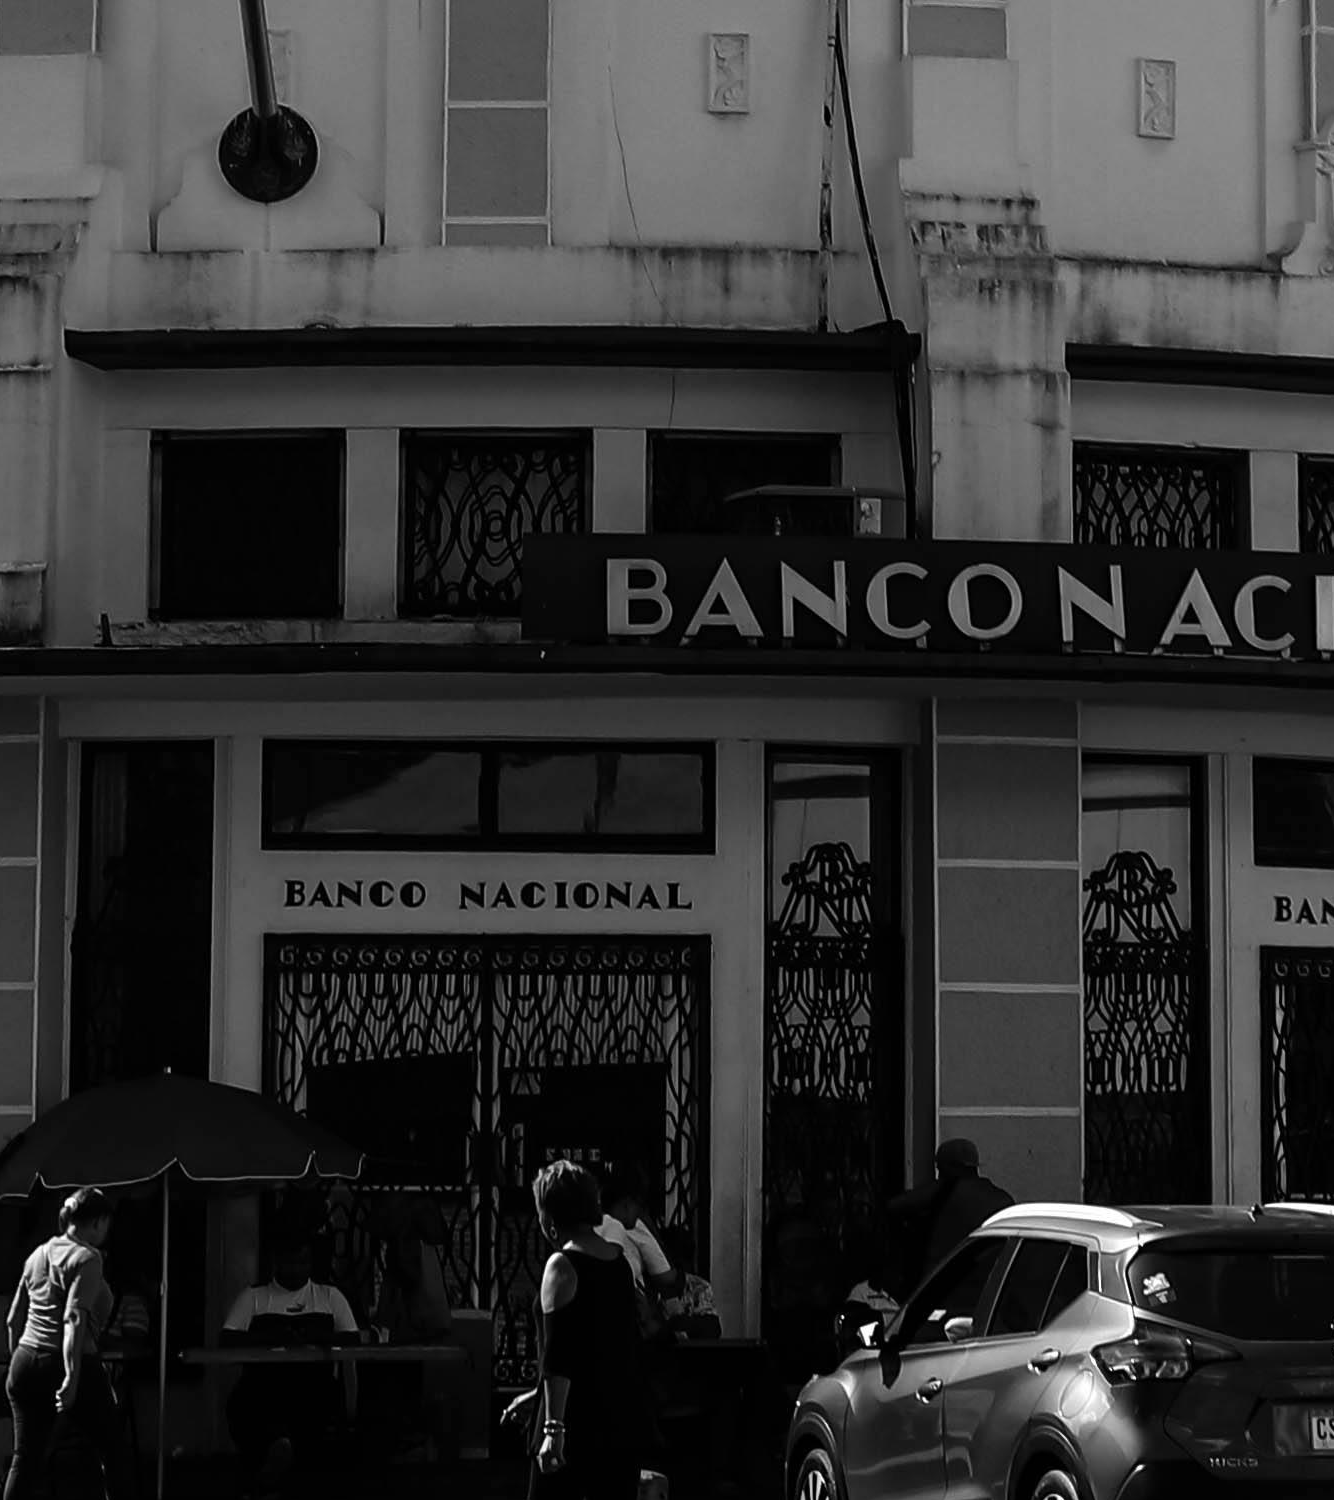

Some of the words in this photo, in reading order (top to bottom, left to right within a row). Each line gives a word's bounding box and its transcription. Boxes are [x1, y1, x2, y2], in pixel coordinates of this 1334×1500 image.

[605, 556, 1023, 640] BANCO
[283, 879, 427, 909] BANCO
[458, 880, 694, 911] NACIONAL
